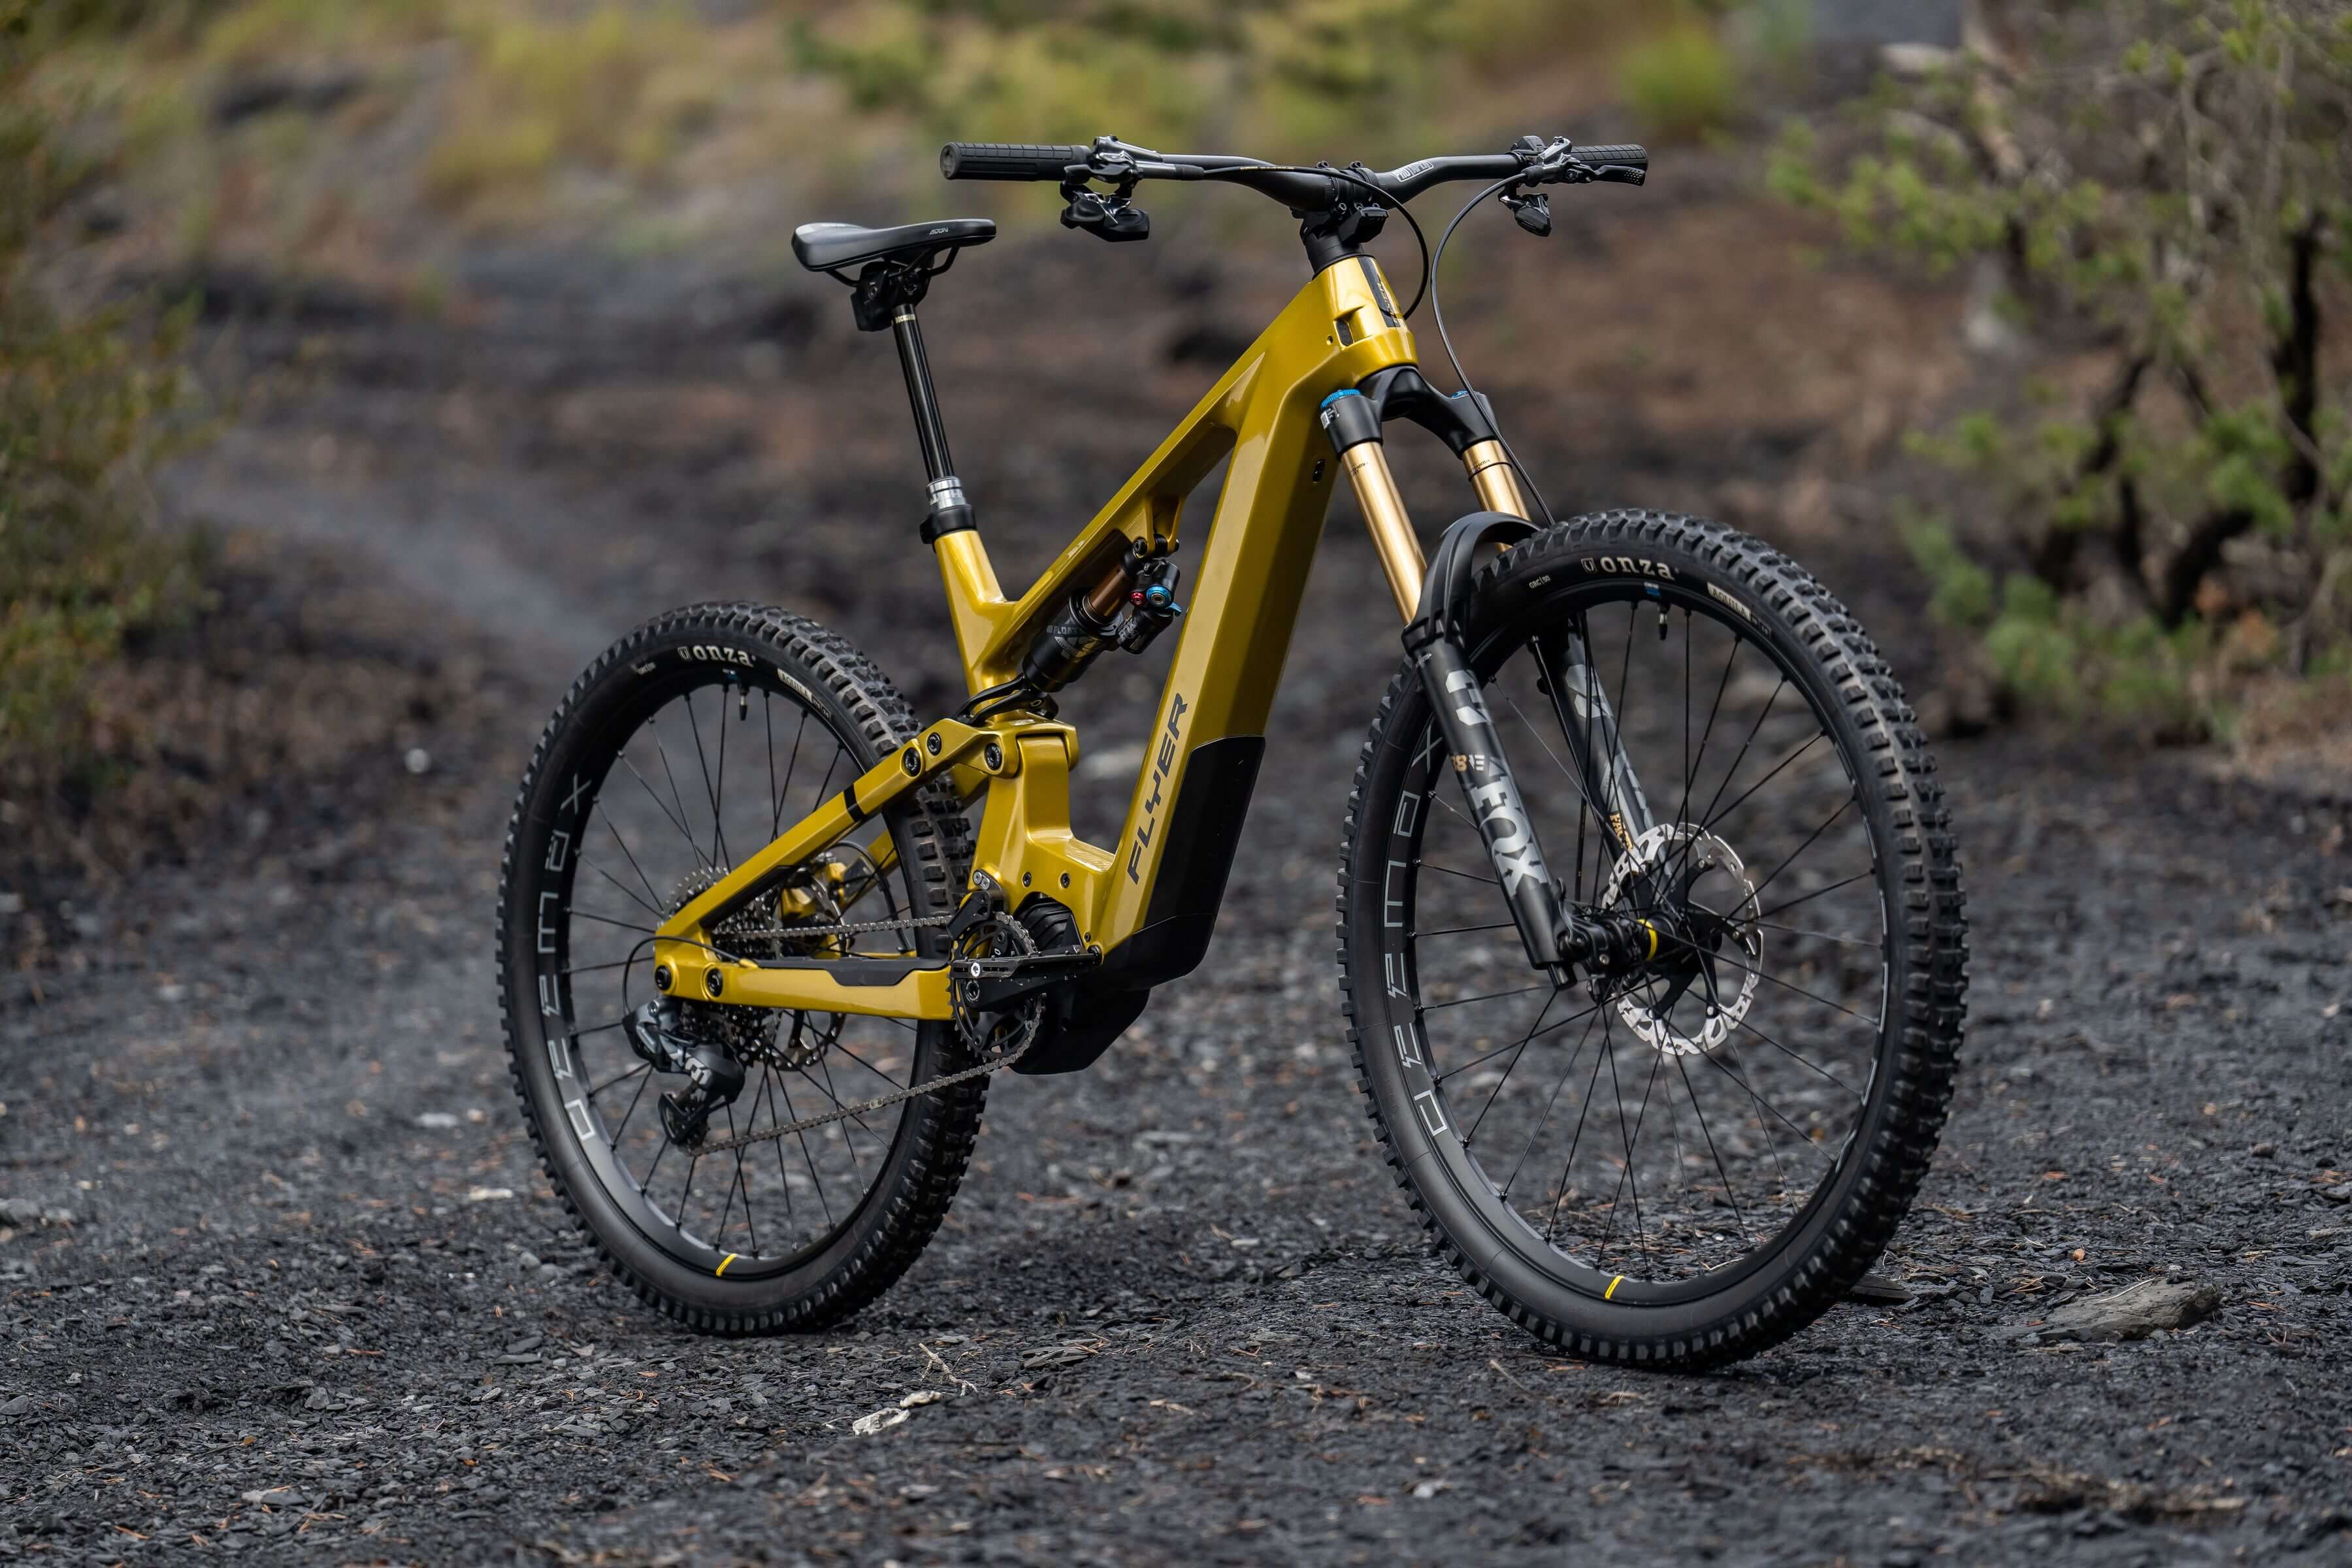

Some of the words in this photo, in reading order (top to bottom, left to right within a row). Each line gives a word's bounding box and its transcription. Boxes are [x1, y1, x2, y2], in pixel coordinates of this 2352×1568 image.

[1600, 557, 1675, 580] onza
[693, 645, 753, 667] onza
[1127, 693, 1188, 885] FLYER
[1470, 776, 1550, 900] FOX
